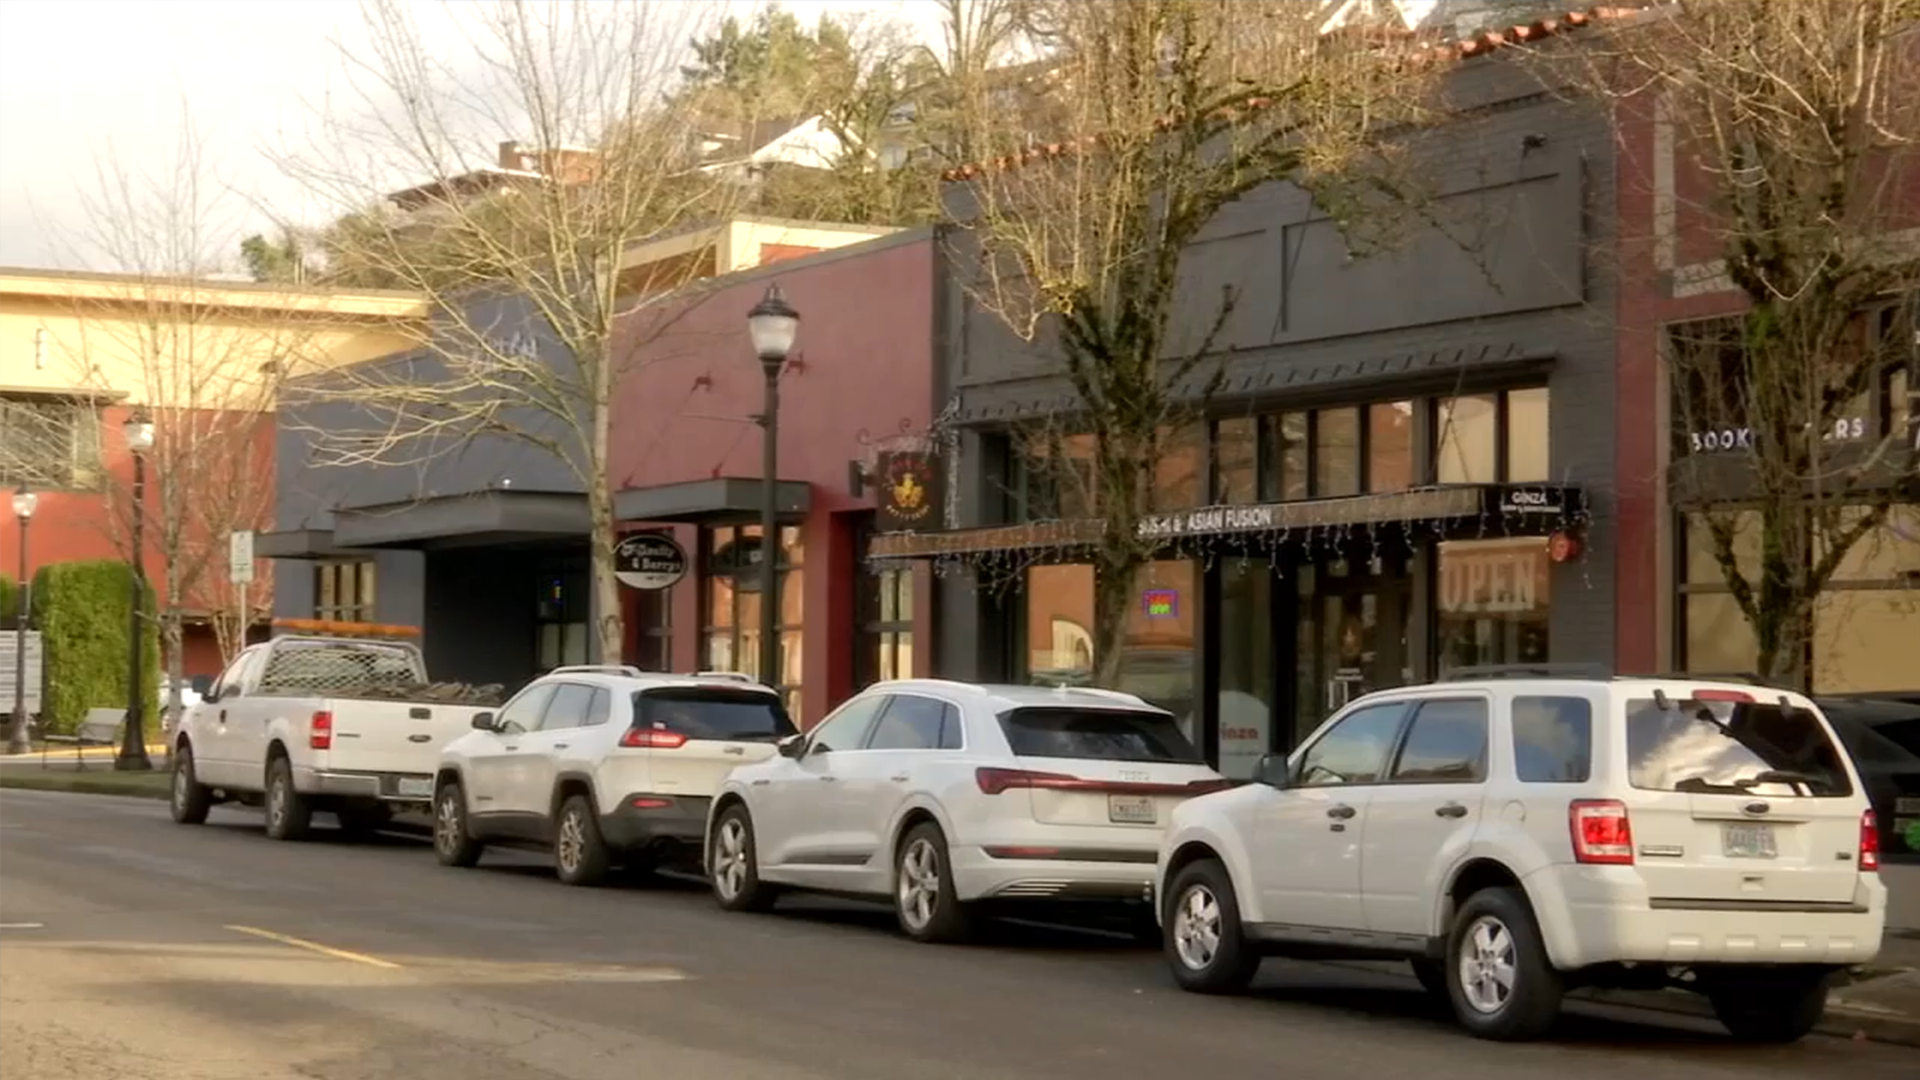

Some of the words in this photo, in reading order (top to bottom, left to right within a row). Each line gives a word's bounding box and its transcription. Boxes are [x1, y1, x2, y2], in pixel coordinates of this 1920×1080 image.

[1511, 491, 1548, 505] GINZA
[1187, 509, 1223, 531] ASIAN
[1226, 507, 1272, 528] FUSION
[1440, 552, 1535, 613] OPEN
